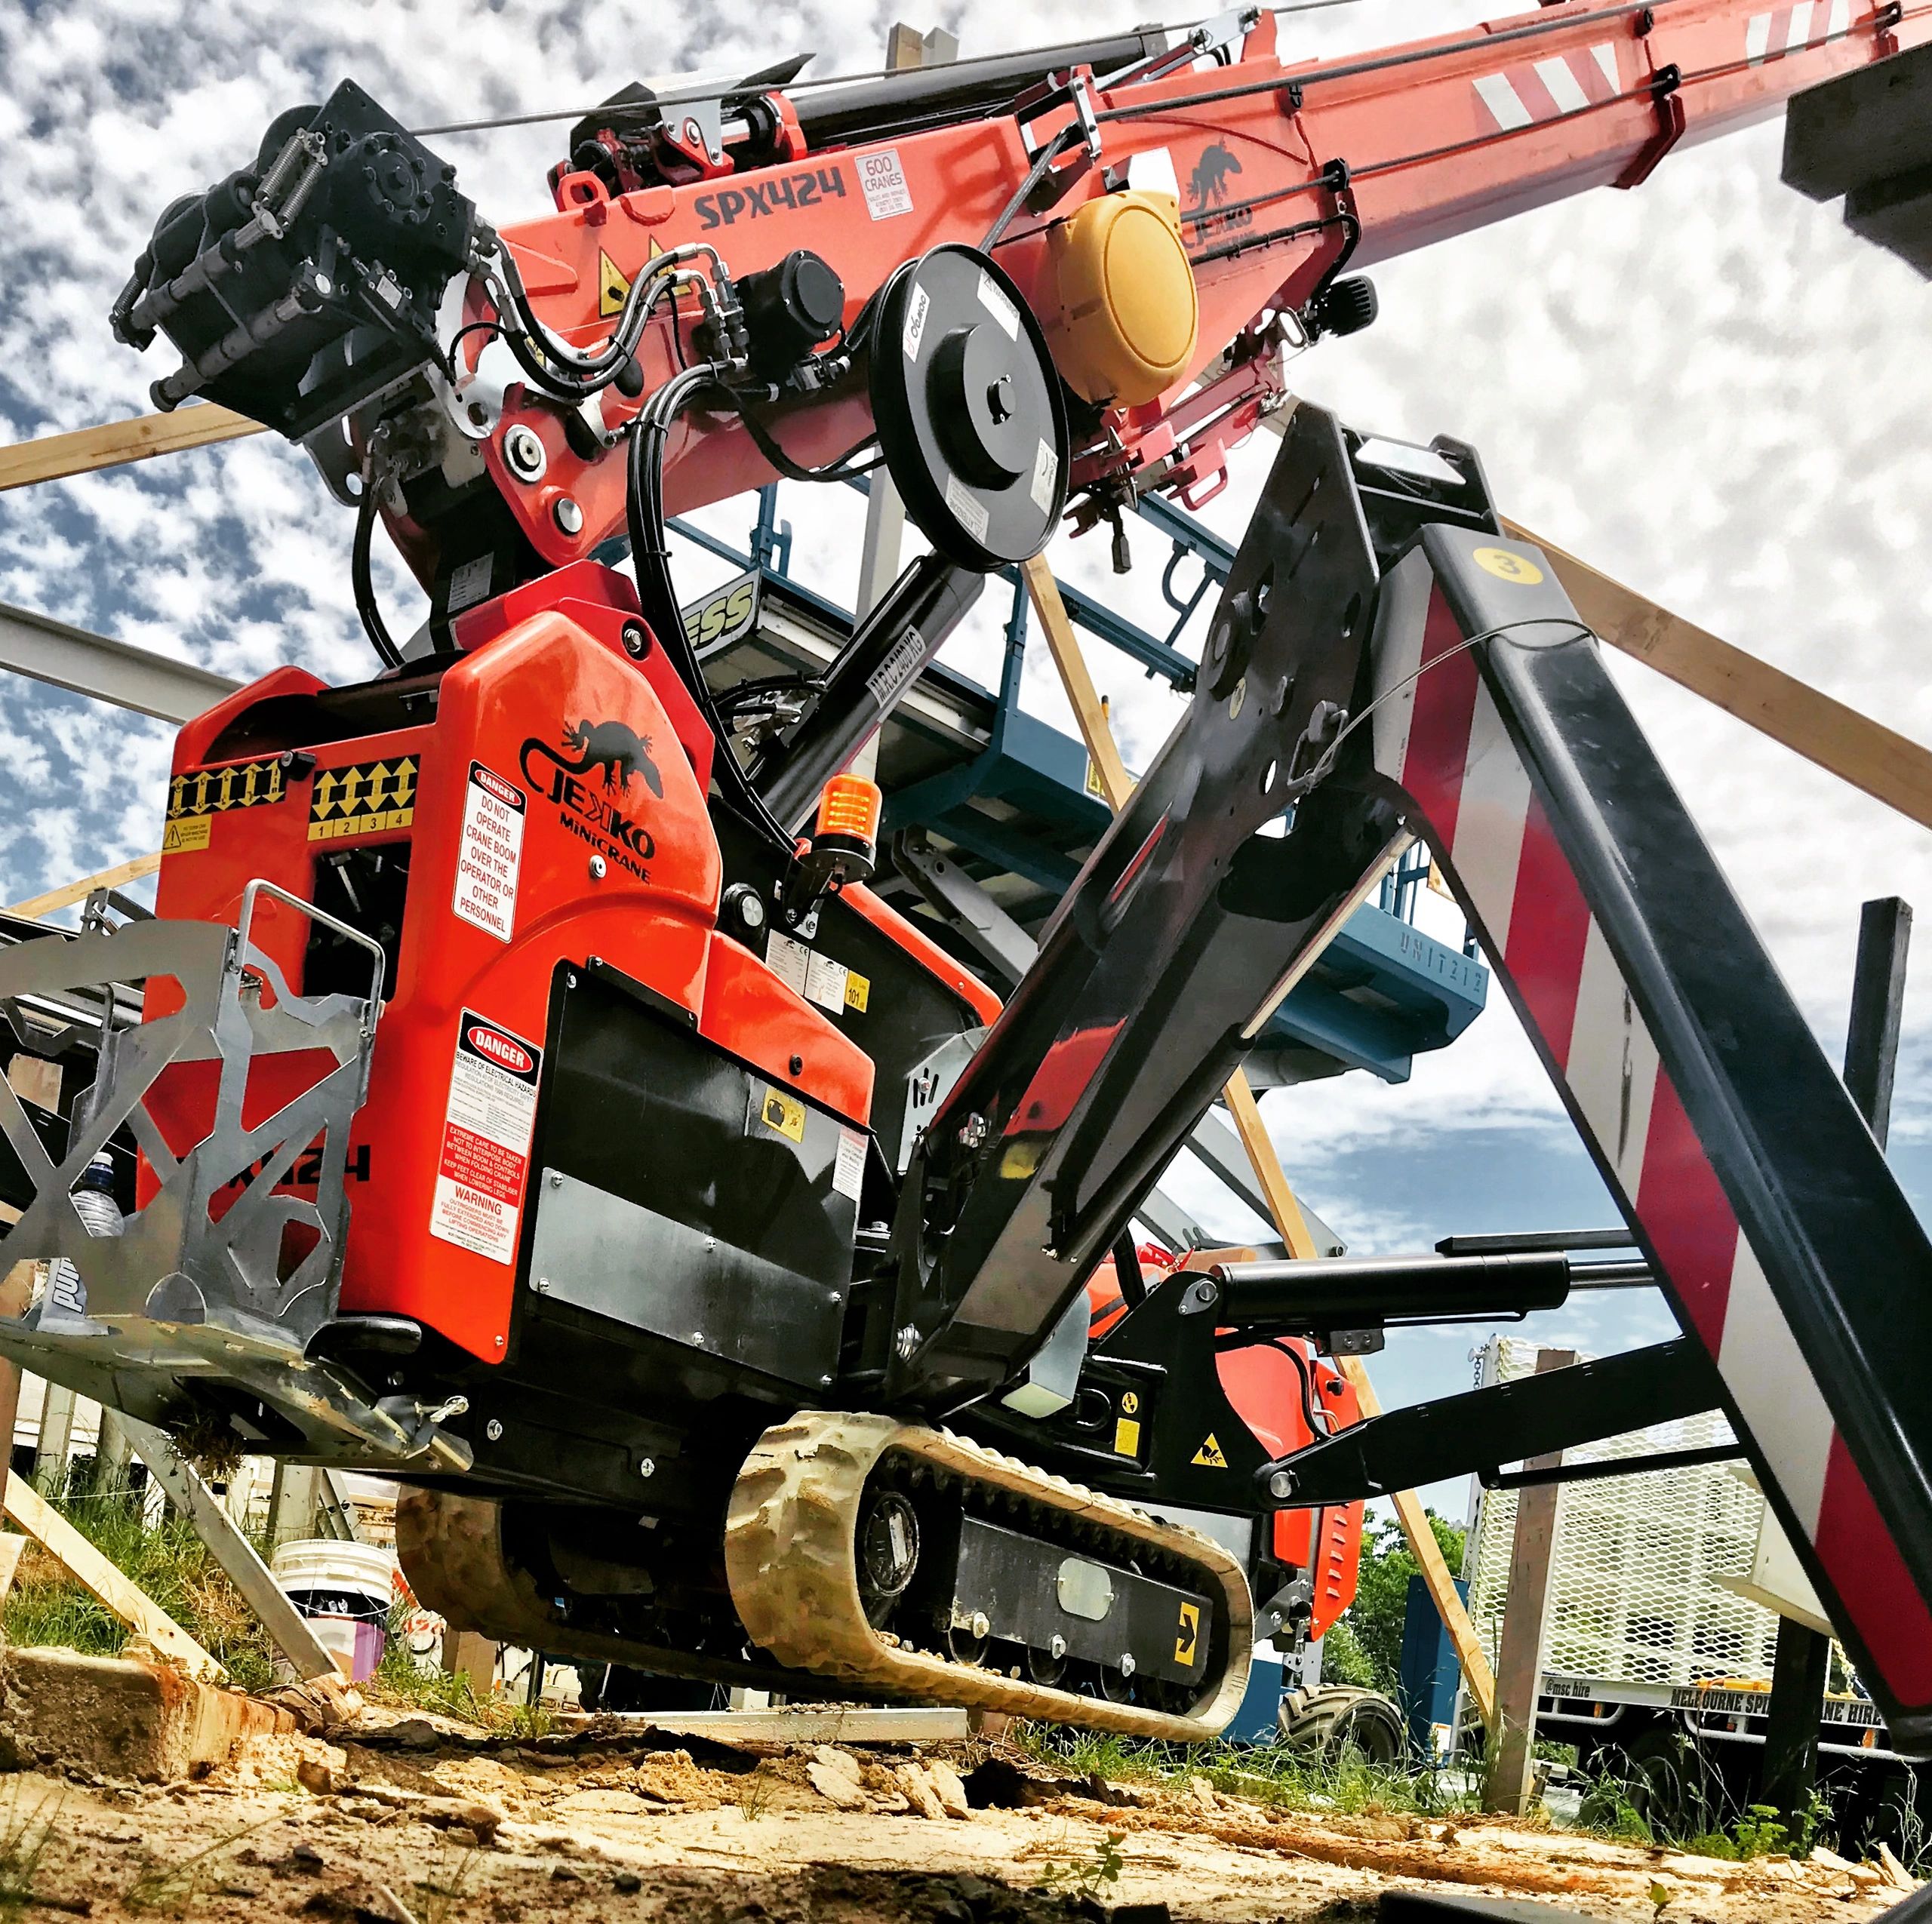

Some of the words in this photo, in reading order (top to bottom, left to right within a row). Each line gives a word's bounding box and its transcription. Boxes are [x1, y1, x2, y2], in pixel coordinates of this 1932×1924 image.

[866, 156, 892, 176] 600
[865, 172, 903, 192] CRANES
[694, 166, 847, 231] SPX424
[1494, 555, 1521, 575] 3
[684, 581, 754, 647] ESS
[480, 772, 515, 802] DANGER
[481, 794, 493, 813] DO
[494, 803, 510, 822] NOT
[318, 825, 324, 837] 1
[343, 822, 349, 833] 2
[370, 818, 377, 829] 3
[395, 813, 402, 825] 4
[476, 811, 511, 842] OPERATE
[466, 824, 493, 850] CRANE
[494, 841, 516, 865] BOOM
[471, 846, 492, 869] OVER
[494, 859, 508, 878] THE
[460, 859, 501, 893] OPERATOR
[503, 884, 513, 899] OR
[472, 885, 498, 910] OTHER
[460, 896, 506, 933] PERSONNEL
[848, 988, 860, 1007] 101
[475, 1029, 525, 1068] DANGER
[456, 1051, 477, 1065] BEWARE
[478, 1062, 485, 1070] OF
[485, 1065, 514, 1086] ELECTRICAL
[449, 1126, 475, 1143] EXTREME
[475, 1138, 489, 1150] CARE
[490, 1144, 497, 1153] TO
[497, 1148, 505, 1157] BE
[506, 1151, 521, 1164] TAKEN
[454, 1136, 464, 1145] NOT
[465, 1141, 472, 1149] TO
[472, 1145, 502, 1163] INTERPOSE
[502, 1158, 516, 1169] BODY
[444, 1158, 457, 1168] KEEP
[457, 1164, 469, 1174] FEET
[469, 1169, 486, 1182] CLEAR
[447, 1141, 472, 1157] BETWEEN
[472, 1153, 488, 1164] BOOM
[494, 1163, 520, 1180] CONTROLS
[454, 1153, 470, 1165] WHEN
[471, 1160, 494, 1175] FOLDING
[494, 1171, 512, 1183] CRANE
[454, 1170, 468, 1182] WHEN
[469, 1177, 493, 1193] LOWERING
[449, 1198, 481, 1216] OUTRIGGERS
[482, 1211, 496, 1222] MUST
[455, 1185, 502, 1216] WARNING
[441, 1201, 457, 1212] FULLY
[457, 1206, 483, 1222] EXTENDED
[484, 1219, 494, 1228] AND
[494, 1224, 509, 1234] DOWN
[442, 1209, 462, 1222] BEFORE
[463, 1217, 496, 1235] COMMENCING
[448, 1217, 467, 1230] LIFTING
[468, 1225, 499, 1243] OPERATIONS
[1545, 1678, 1571, 1698] @msc
[1571, 1681, 1591, 1698] hire
[1746, 1694, 1770, 1714] SPI
